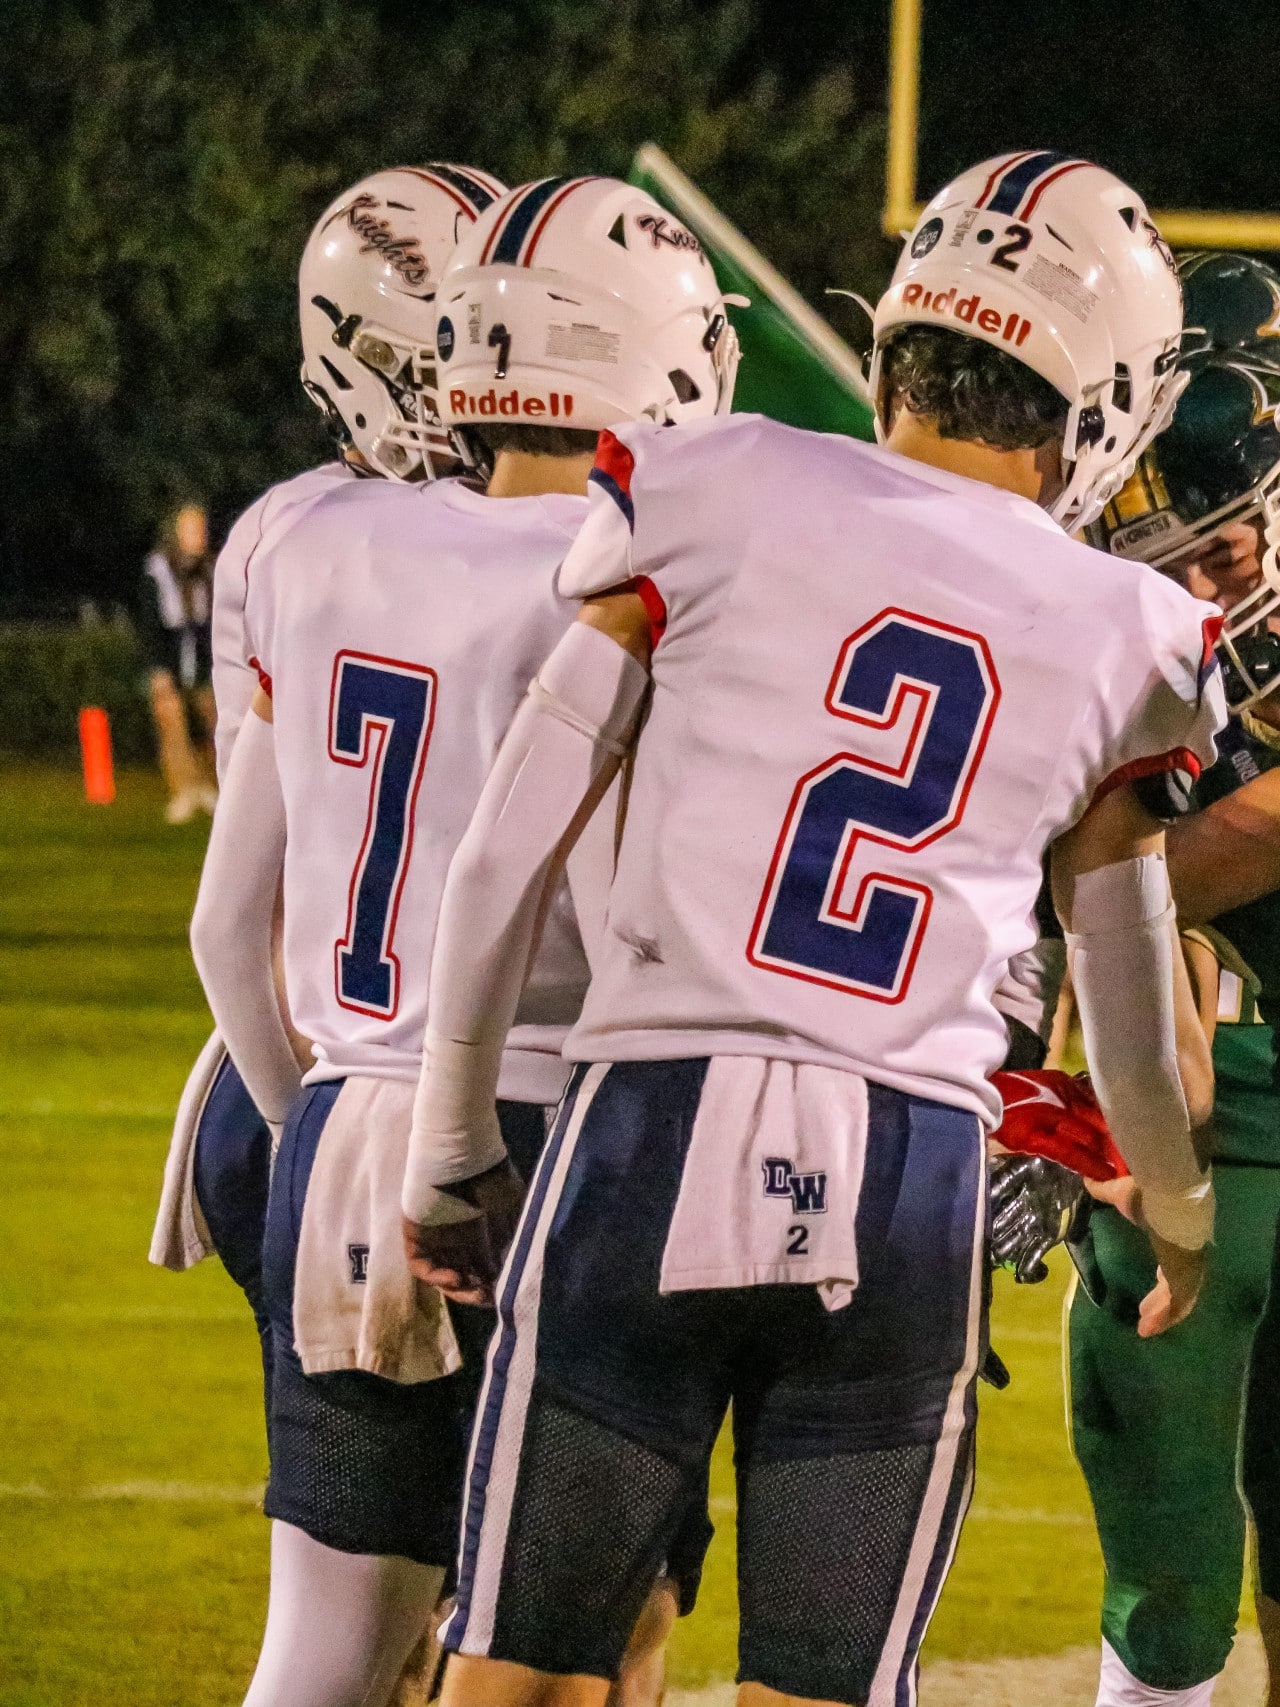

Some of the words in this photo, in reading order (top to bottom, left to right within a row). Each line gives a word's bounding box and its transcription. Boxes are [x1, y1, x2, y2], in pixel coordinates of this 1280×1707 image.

[990, 223, 1033, 273] 2
[902, 283, 1032, 347] Riddell
[449, 389, 574, 418] Riddell
[328, 649, 437, 1021] 7
[746, 607, 1001, 1005] 2
[762, 1157, 828, 1215] DW
[786, 1225, 809, 1256] 2
